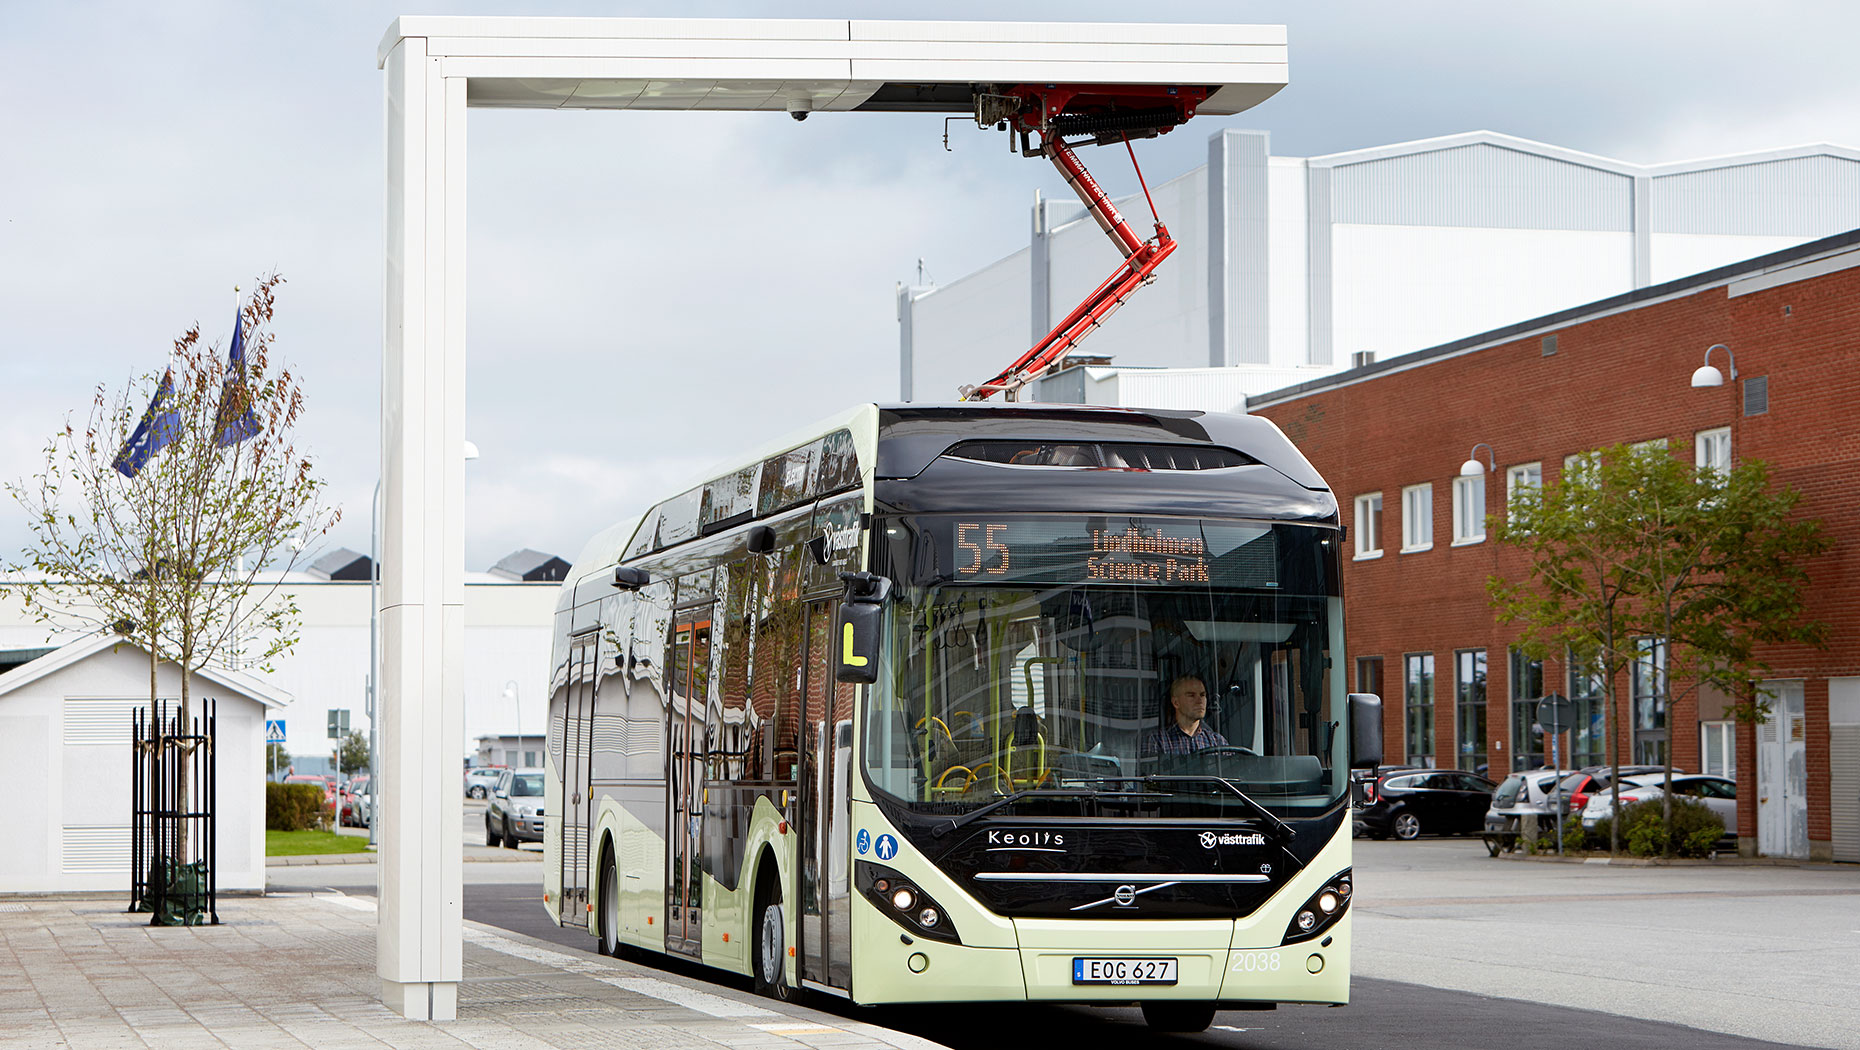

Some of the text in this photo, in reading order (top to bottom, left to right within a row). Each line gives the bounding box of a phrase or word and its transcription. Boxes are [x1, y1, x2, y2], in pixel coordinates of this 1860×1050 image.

[958, 523, 1009, 574] 55
[1088, 557, 1208, 581] Science Park
[988, 830, 1064, 846] Keolis
[1218, 833, 1265, 846] västtrafik
[1091, 962, 1126, 979] EOG
[1132, 962, 1169, 979] 627
[1231, 953, 1280, 972] 2038
